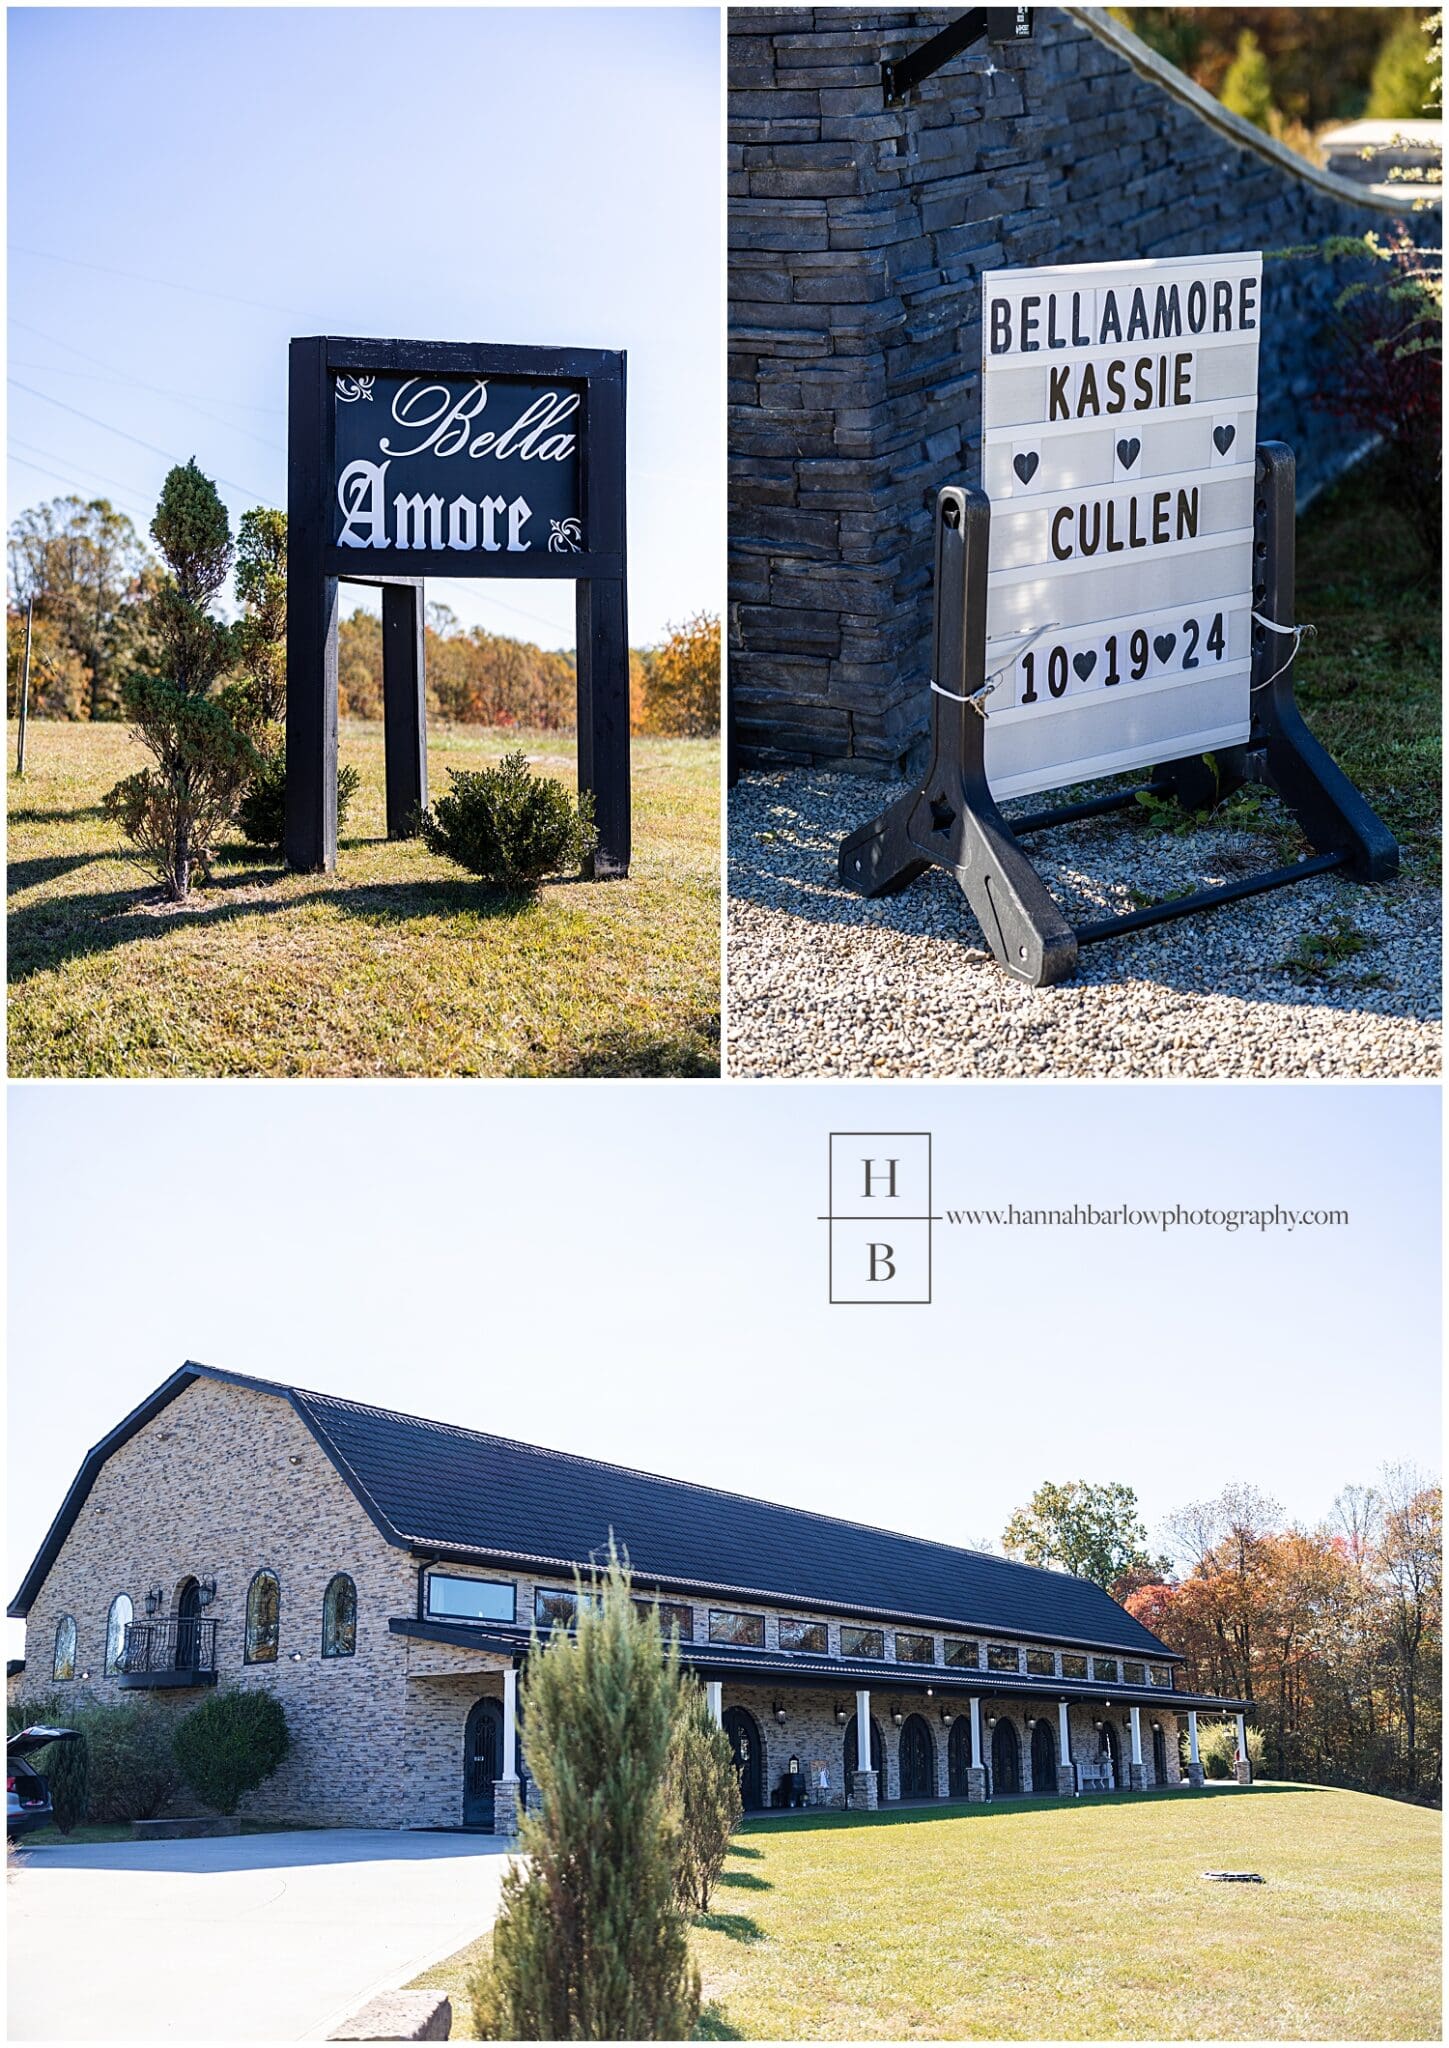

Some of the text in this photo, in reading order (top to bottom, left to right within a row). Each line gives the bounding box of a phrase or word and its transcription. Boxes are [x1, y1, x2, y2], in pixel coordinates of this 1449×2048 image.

[990, 277, 1257, 354] BELLAAMORE
[379, 376, 580, 461] Bella
[1049, 352, 1193, 421] KASSIE
[336, 459, 533, 551] Amore
[1052, 487, 1198, 560] CULLEN
